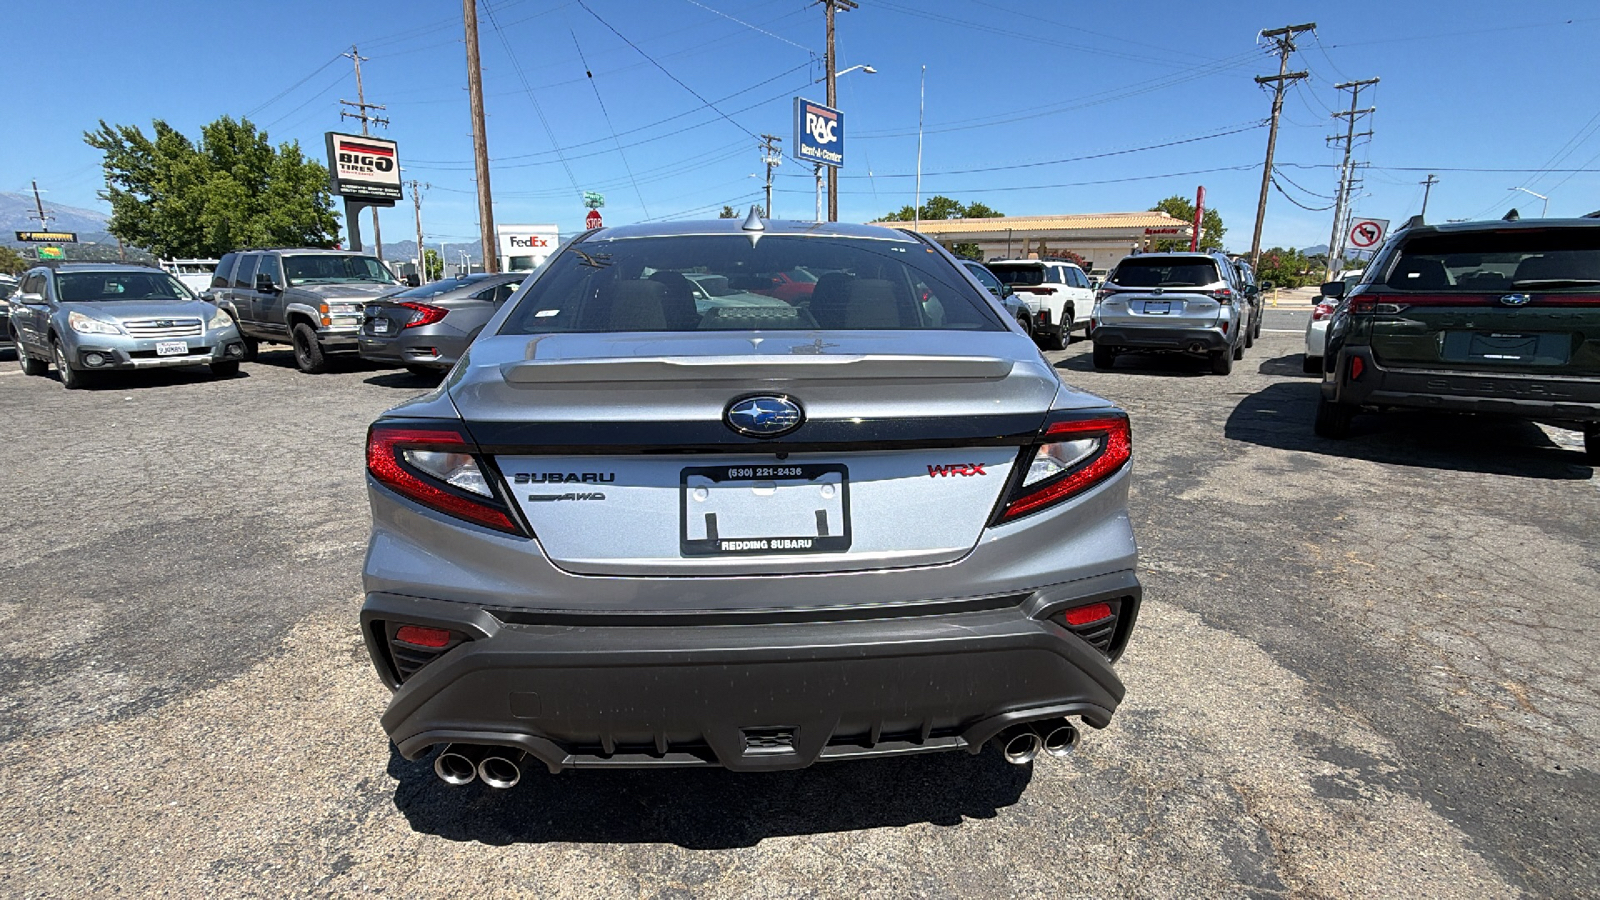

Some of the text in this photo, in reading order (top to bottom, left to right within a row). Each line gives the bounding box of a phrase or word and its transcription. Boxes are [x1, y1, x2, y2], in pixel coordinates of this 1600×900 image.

[806, 112, 837, 144] RAC
[339, 153, 393, 172] BIG O
[340, 164, 374, 172] TIRES
[586, 218, 602, 229] STOP
[510, 236, 548, 247] FedEx
[728, 467, 802, 478] (530) 221-2436
[927, 463, 987, 478] WRX
[514, 472, 615, 484] SUBARU
[721, 540, 812, 551] REDDING SUBARU
